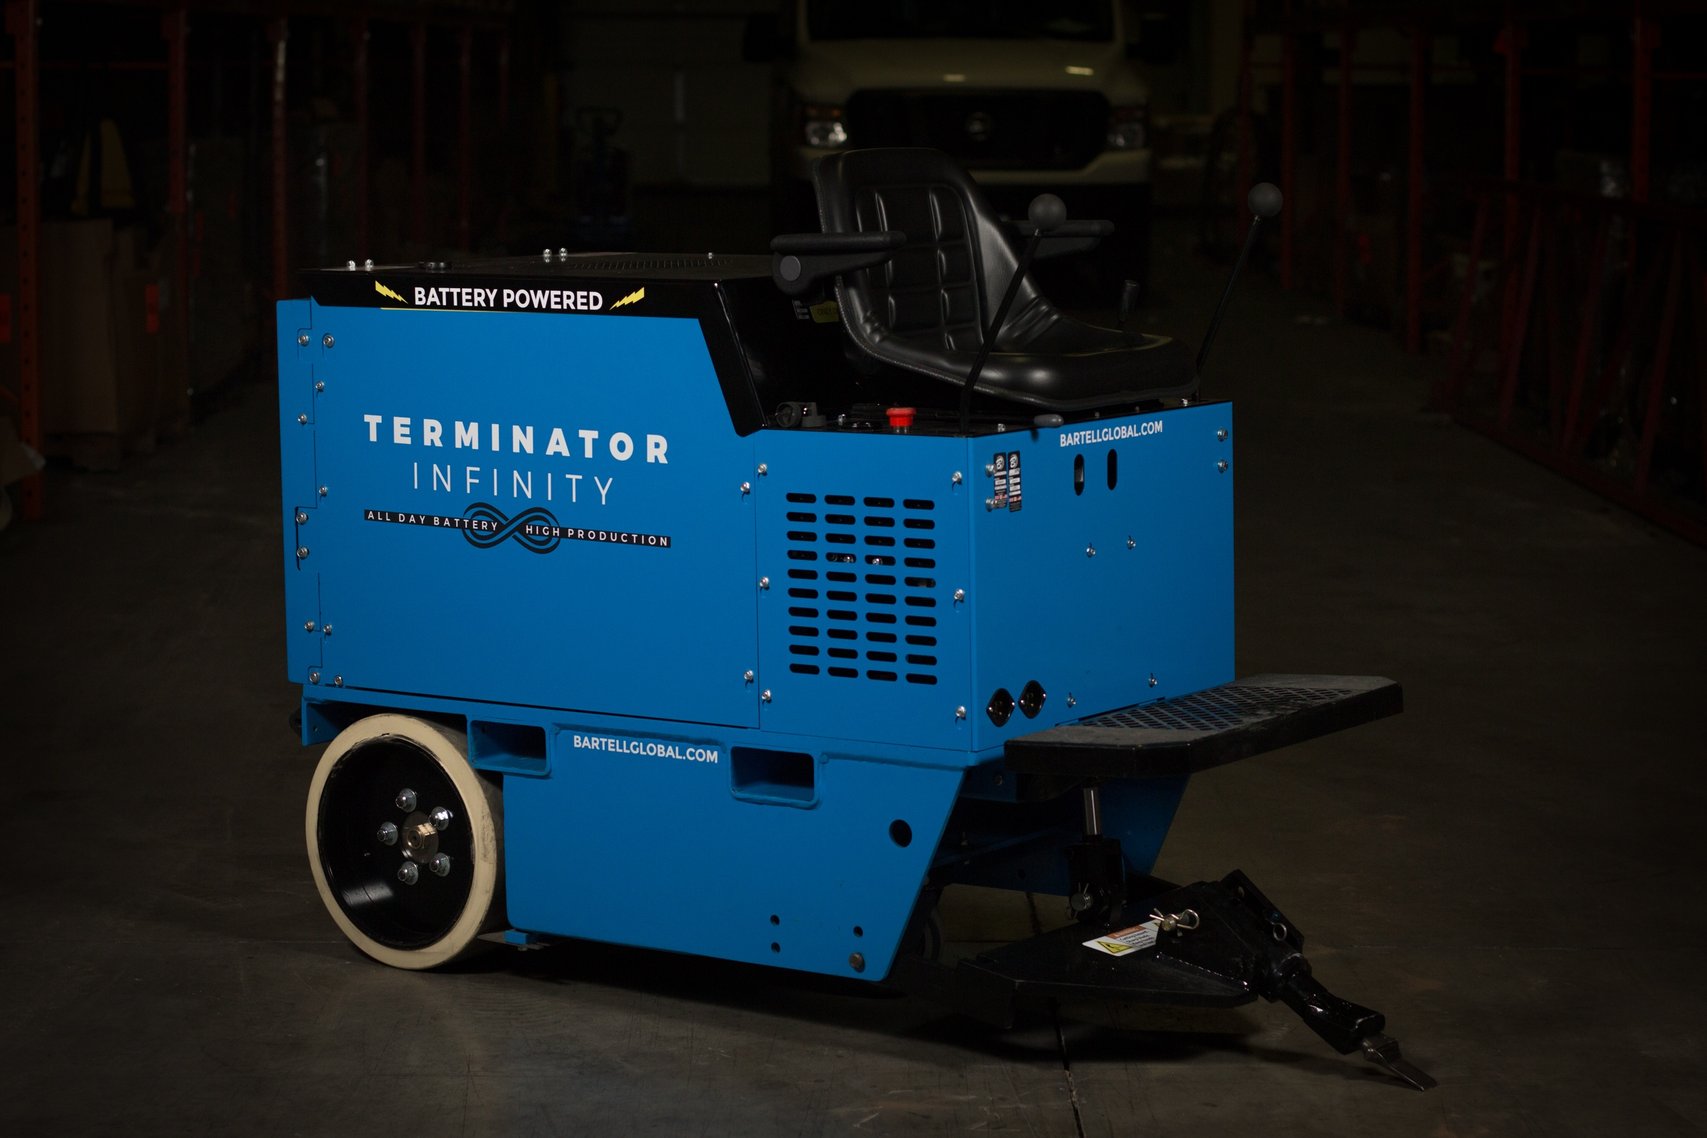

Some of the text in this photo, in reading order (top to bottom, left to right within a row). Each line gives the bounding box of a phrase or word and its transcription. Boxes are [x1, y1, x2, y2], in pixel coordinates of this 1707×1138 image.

[414, 286, 603, 311] BATTERY POWERED
[364, 414, 668, 463] TERMINATOR
[1060, 420, 1162, 447] BARTELLGLOBAL.COM
[414, 462, 613, 505] INFINITY
[367, 510, 498, 531] ALL DAY BATTERY
[525, 524, 668, 547] HIGH PRODUCTION
[573, 735, 718, 763] BARTELLGLOBAL.COM
